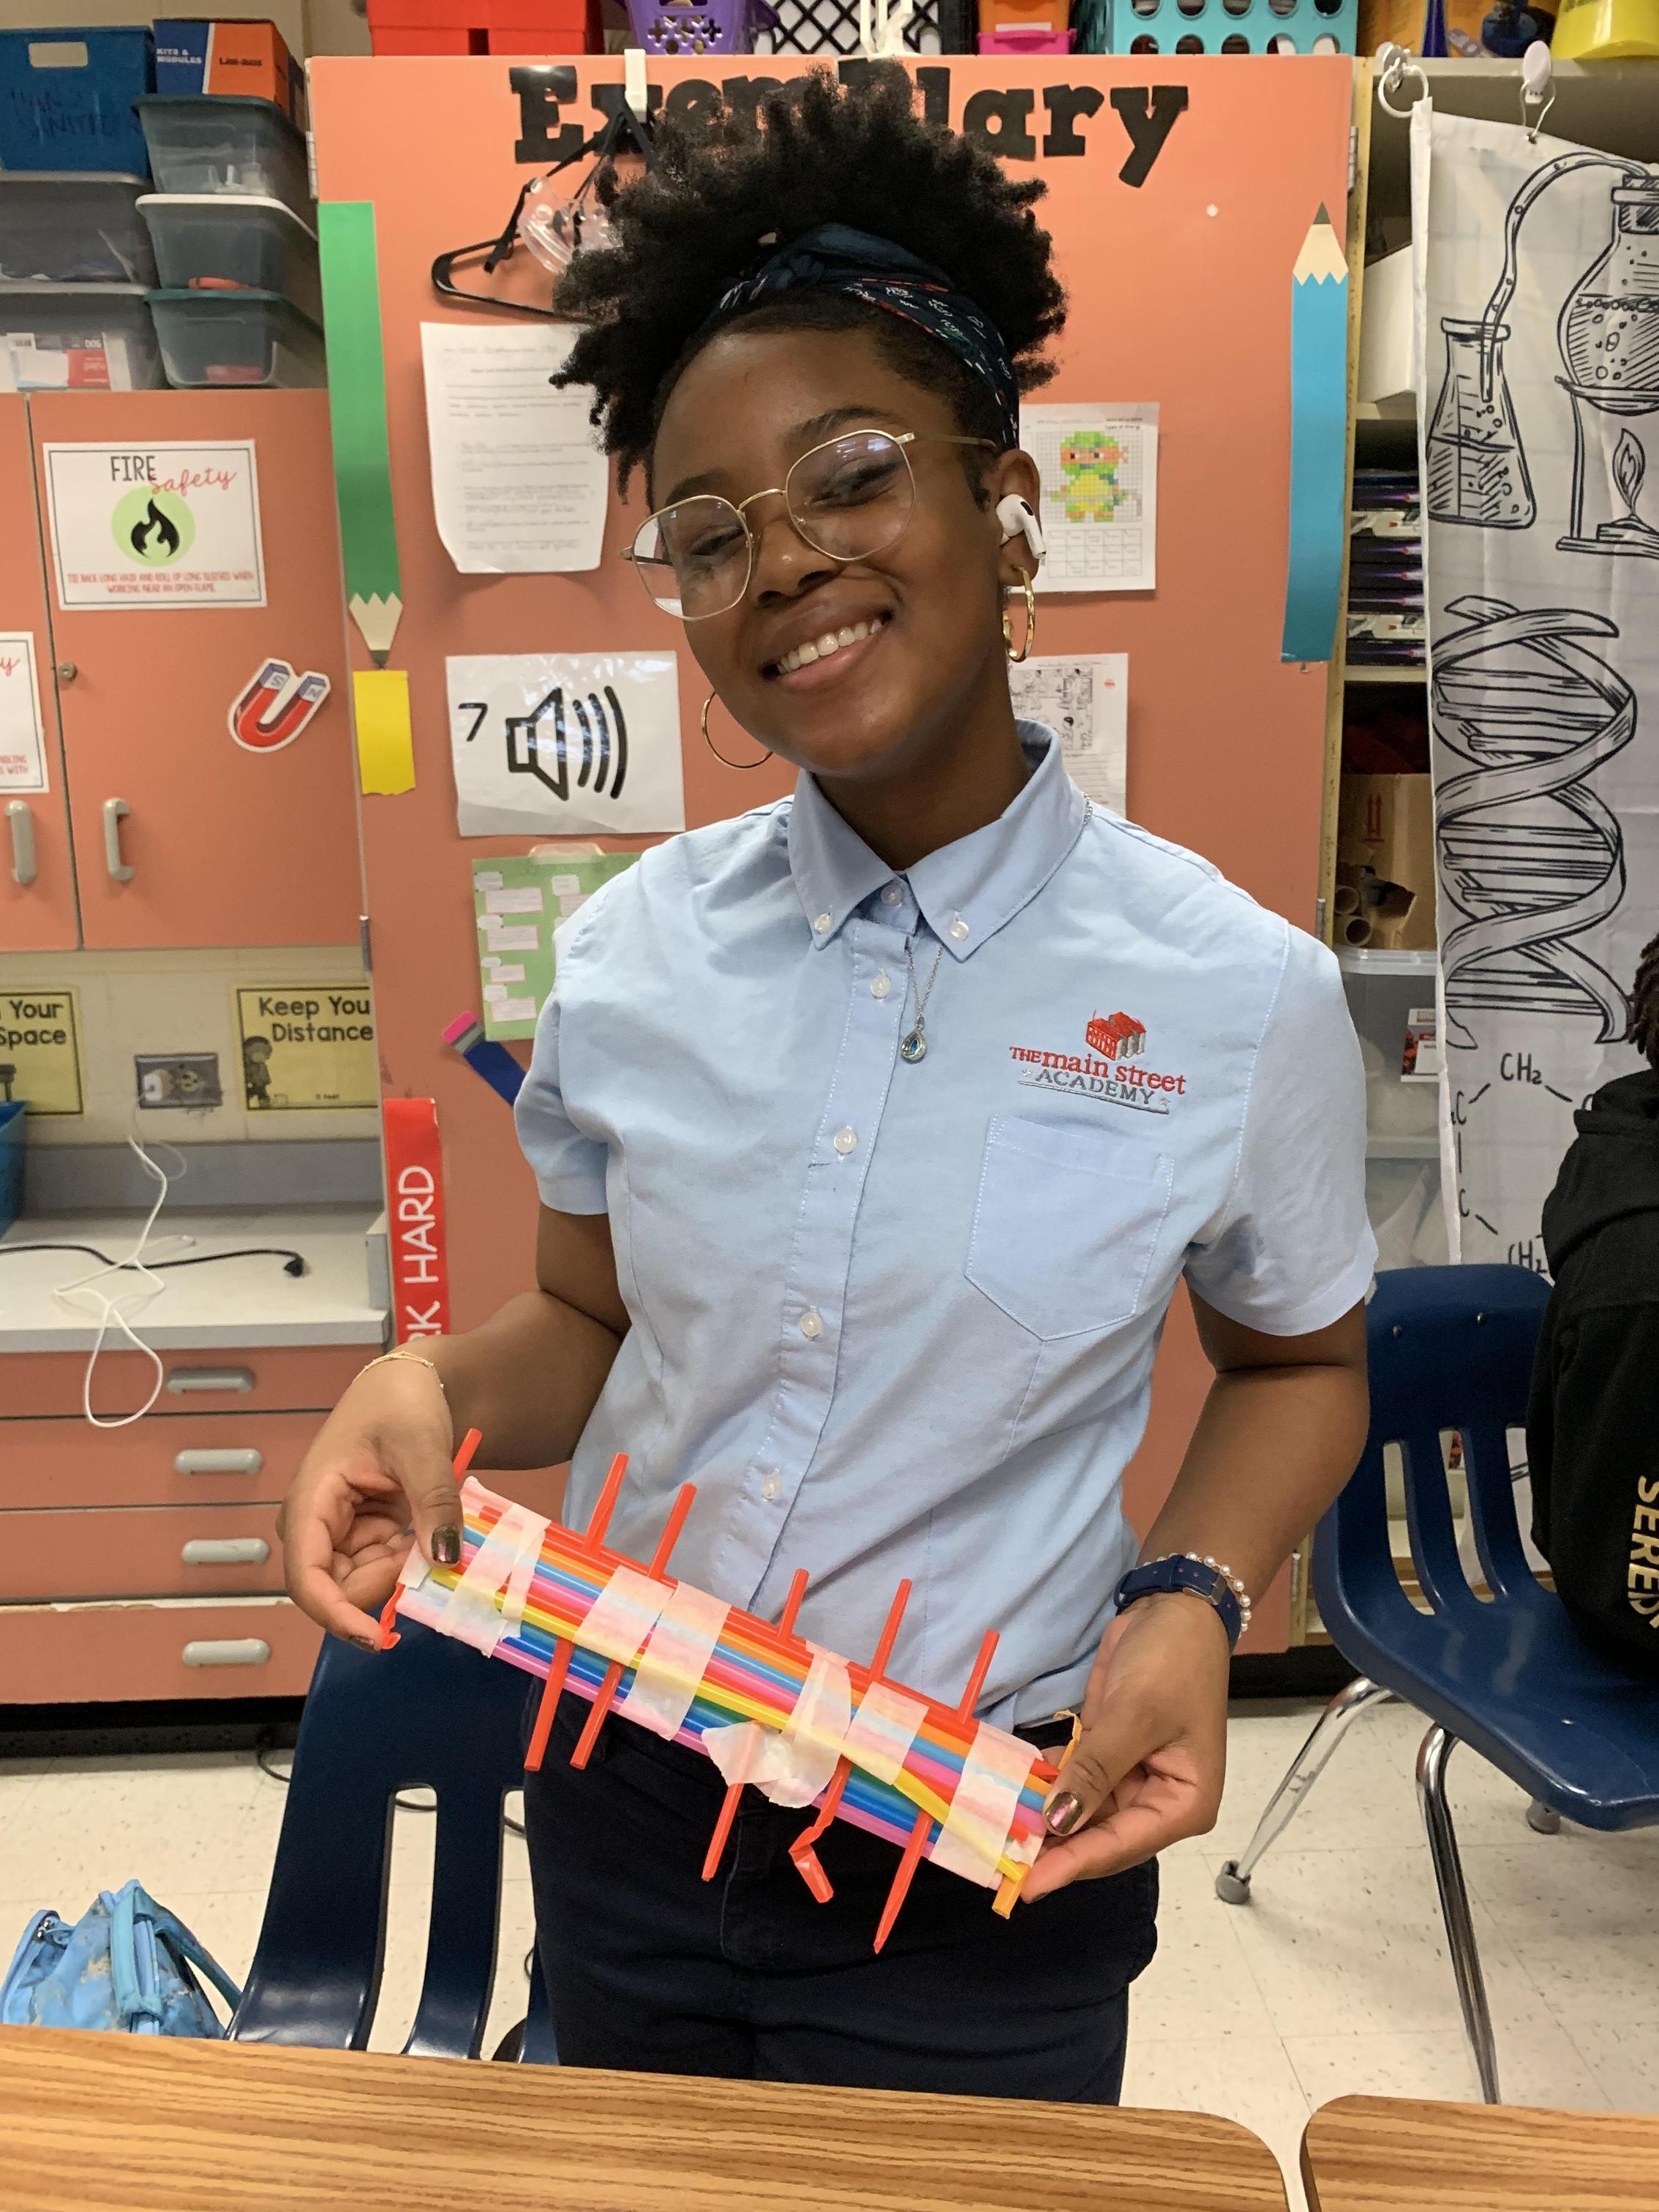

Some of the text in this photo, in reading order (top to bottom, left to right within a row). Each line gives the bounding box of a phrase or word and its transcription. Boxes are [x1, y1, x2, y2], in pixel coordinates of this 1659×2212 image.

[157, 56, 202, 64] MODULES
[110, 456, 157, 481] FIRE
[148, 467, 237, 497] safety
[458, 702, 488, 742] 7
[10, 999, 64, 1020] Your
[258, 995, 370, 1020] Keep You
[0, 1026, 67, 1050] Space
[271, 1023, 374, 1043] Distance
[1009, 1046, 1186, 1095] THE main street
[1035, 1069, 1155, 1104] ACADEMY
[397, 1165, 440, 1284] HARD
